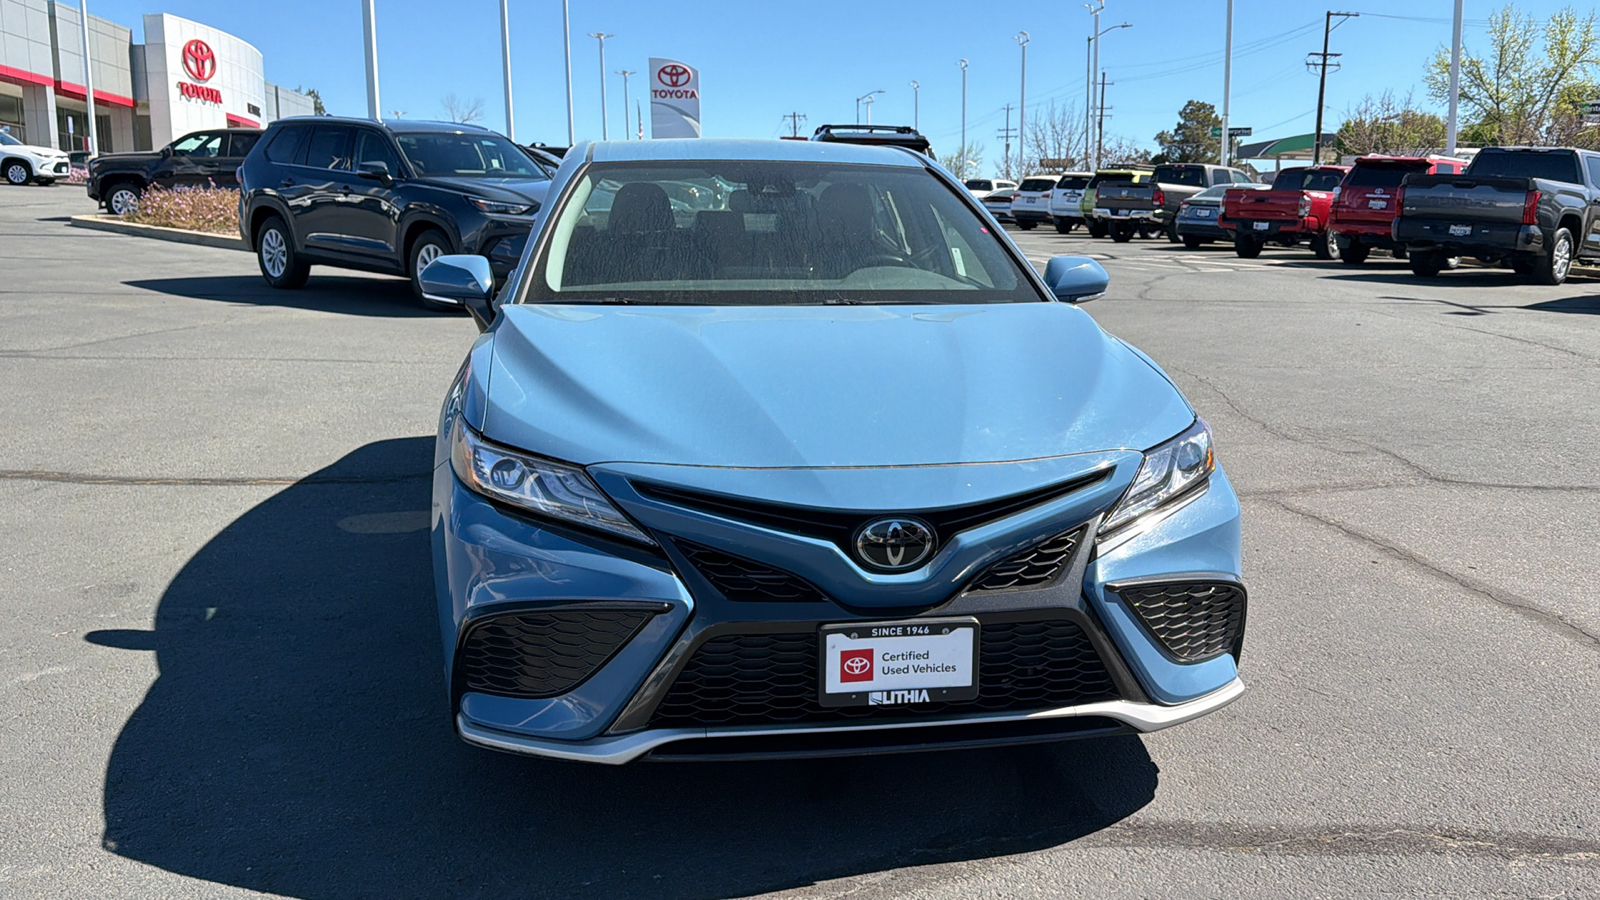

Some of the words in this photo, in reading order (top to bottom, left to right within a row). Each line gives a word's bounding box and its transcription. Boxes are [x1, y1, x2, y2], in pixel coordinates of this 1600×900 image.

[177, 81, 223, 104] TOYOTA
[652, 89, 698, 99] TOYOTA
[871, 627, 903, 637] SINCE
[906, 626, 930, 635] 1946
[882, 650, 930, 662] Certified
[882, 664, 910, 675] Used
[912, 663, 957, 674] Vehicles
[882, 689, 930, 704] LITHIA
